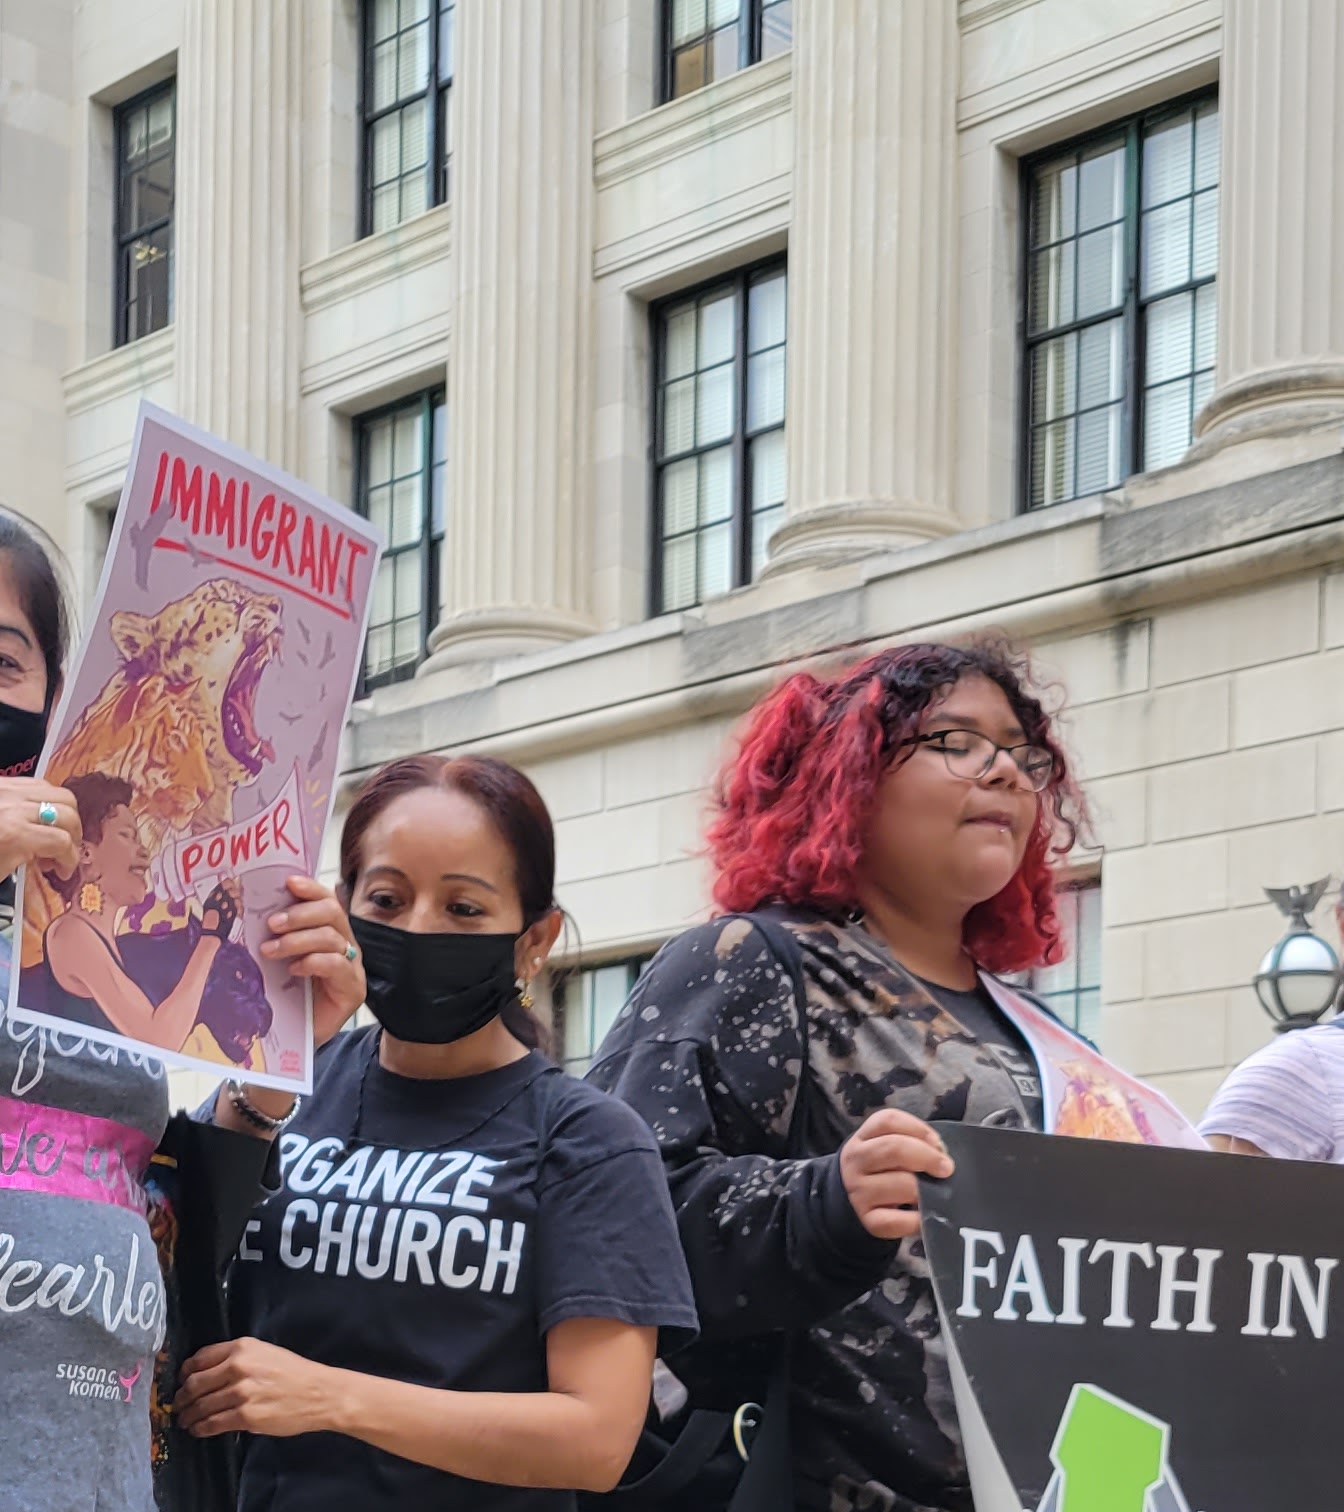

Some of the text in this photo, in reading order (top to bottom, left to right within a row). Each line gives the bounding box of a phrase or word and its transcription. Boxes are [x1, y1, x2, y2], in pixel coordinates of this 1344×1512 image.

[150, 451, 368, 604] IMMIGRANT
[182, 799, 300, 885] POWER
[279, 1132, 506, 1212] RGANIZE
[279, 1198, 526, 1295] CHURCH
[955, 1225, 1223, 1333] FAITH
[1240, 1251, 1339, 1340] IN
